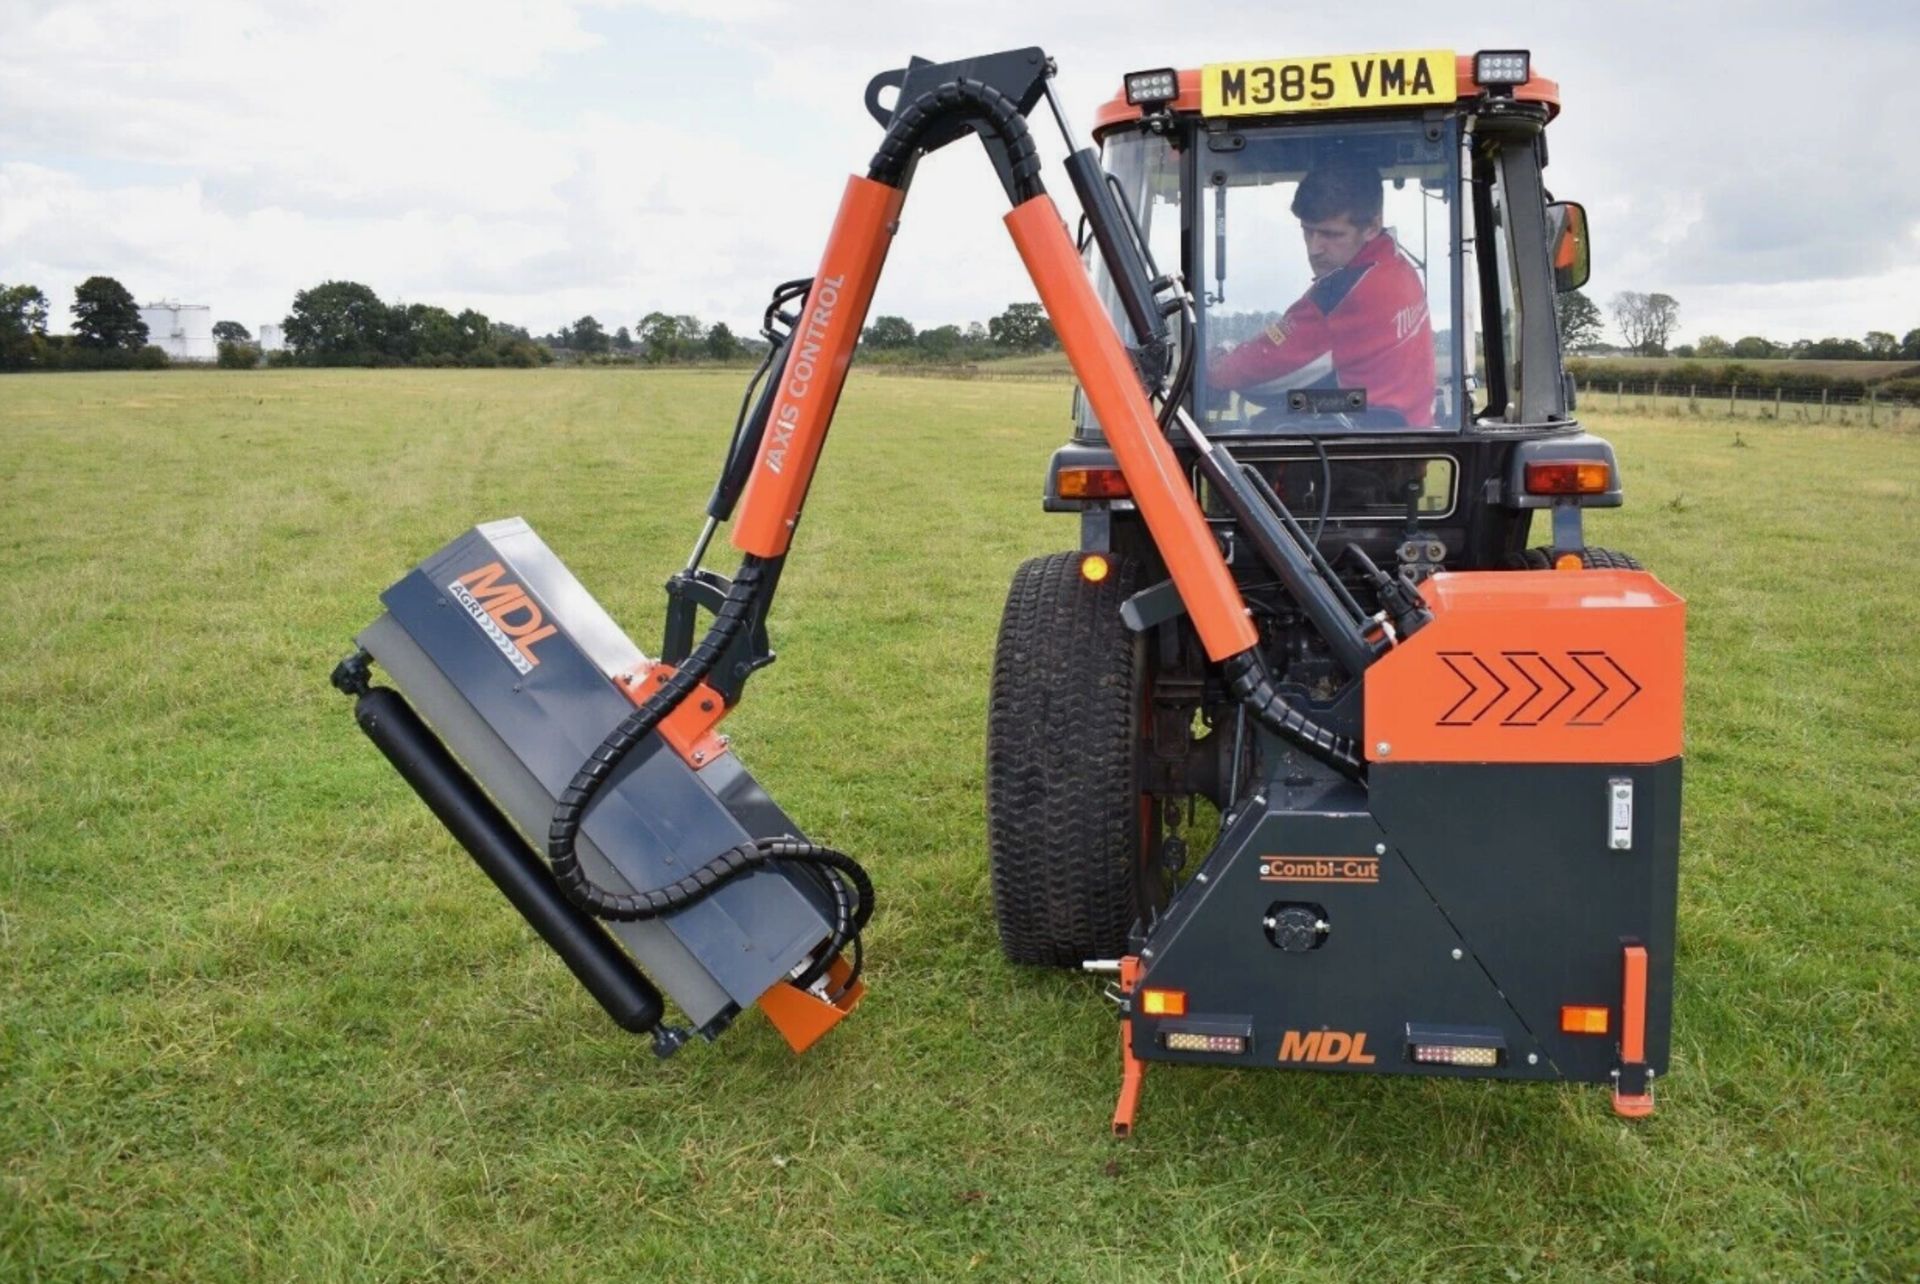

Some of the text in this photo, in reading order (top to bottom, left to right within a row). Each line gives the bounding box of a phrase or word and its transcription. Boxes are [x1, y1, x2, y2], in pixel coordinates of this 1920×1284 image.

[1221, 57, 1435, 106] M385 VMA
[788, 274, 845, 397] CONTROL
[451, 585, 485, 619] AGRI
[457, 561, 558, 667] MDL
[1259, 861, 1379, 877] eCombi-Cut
[1278, 1031, 1377, 1064] MDL
